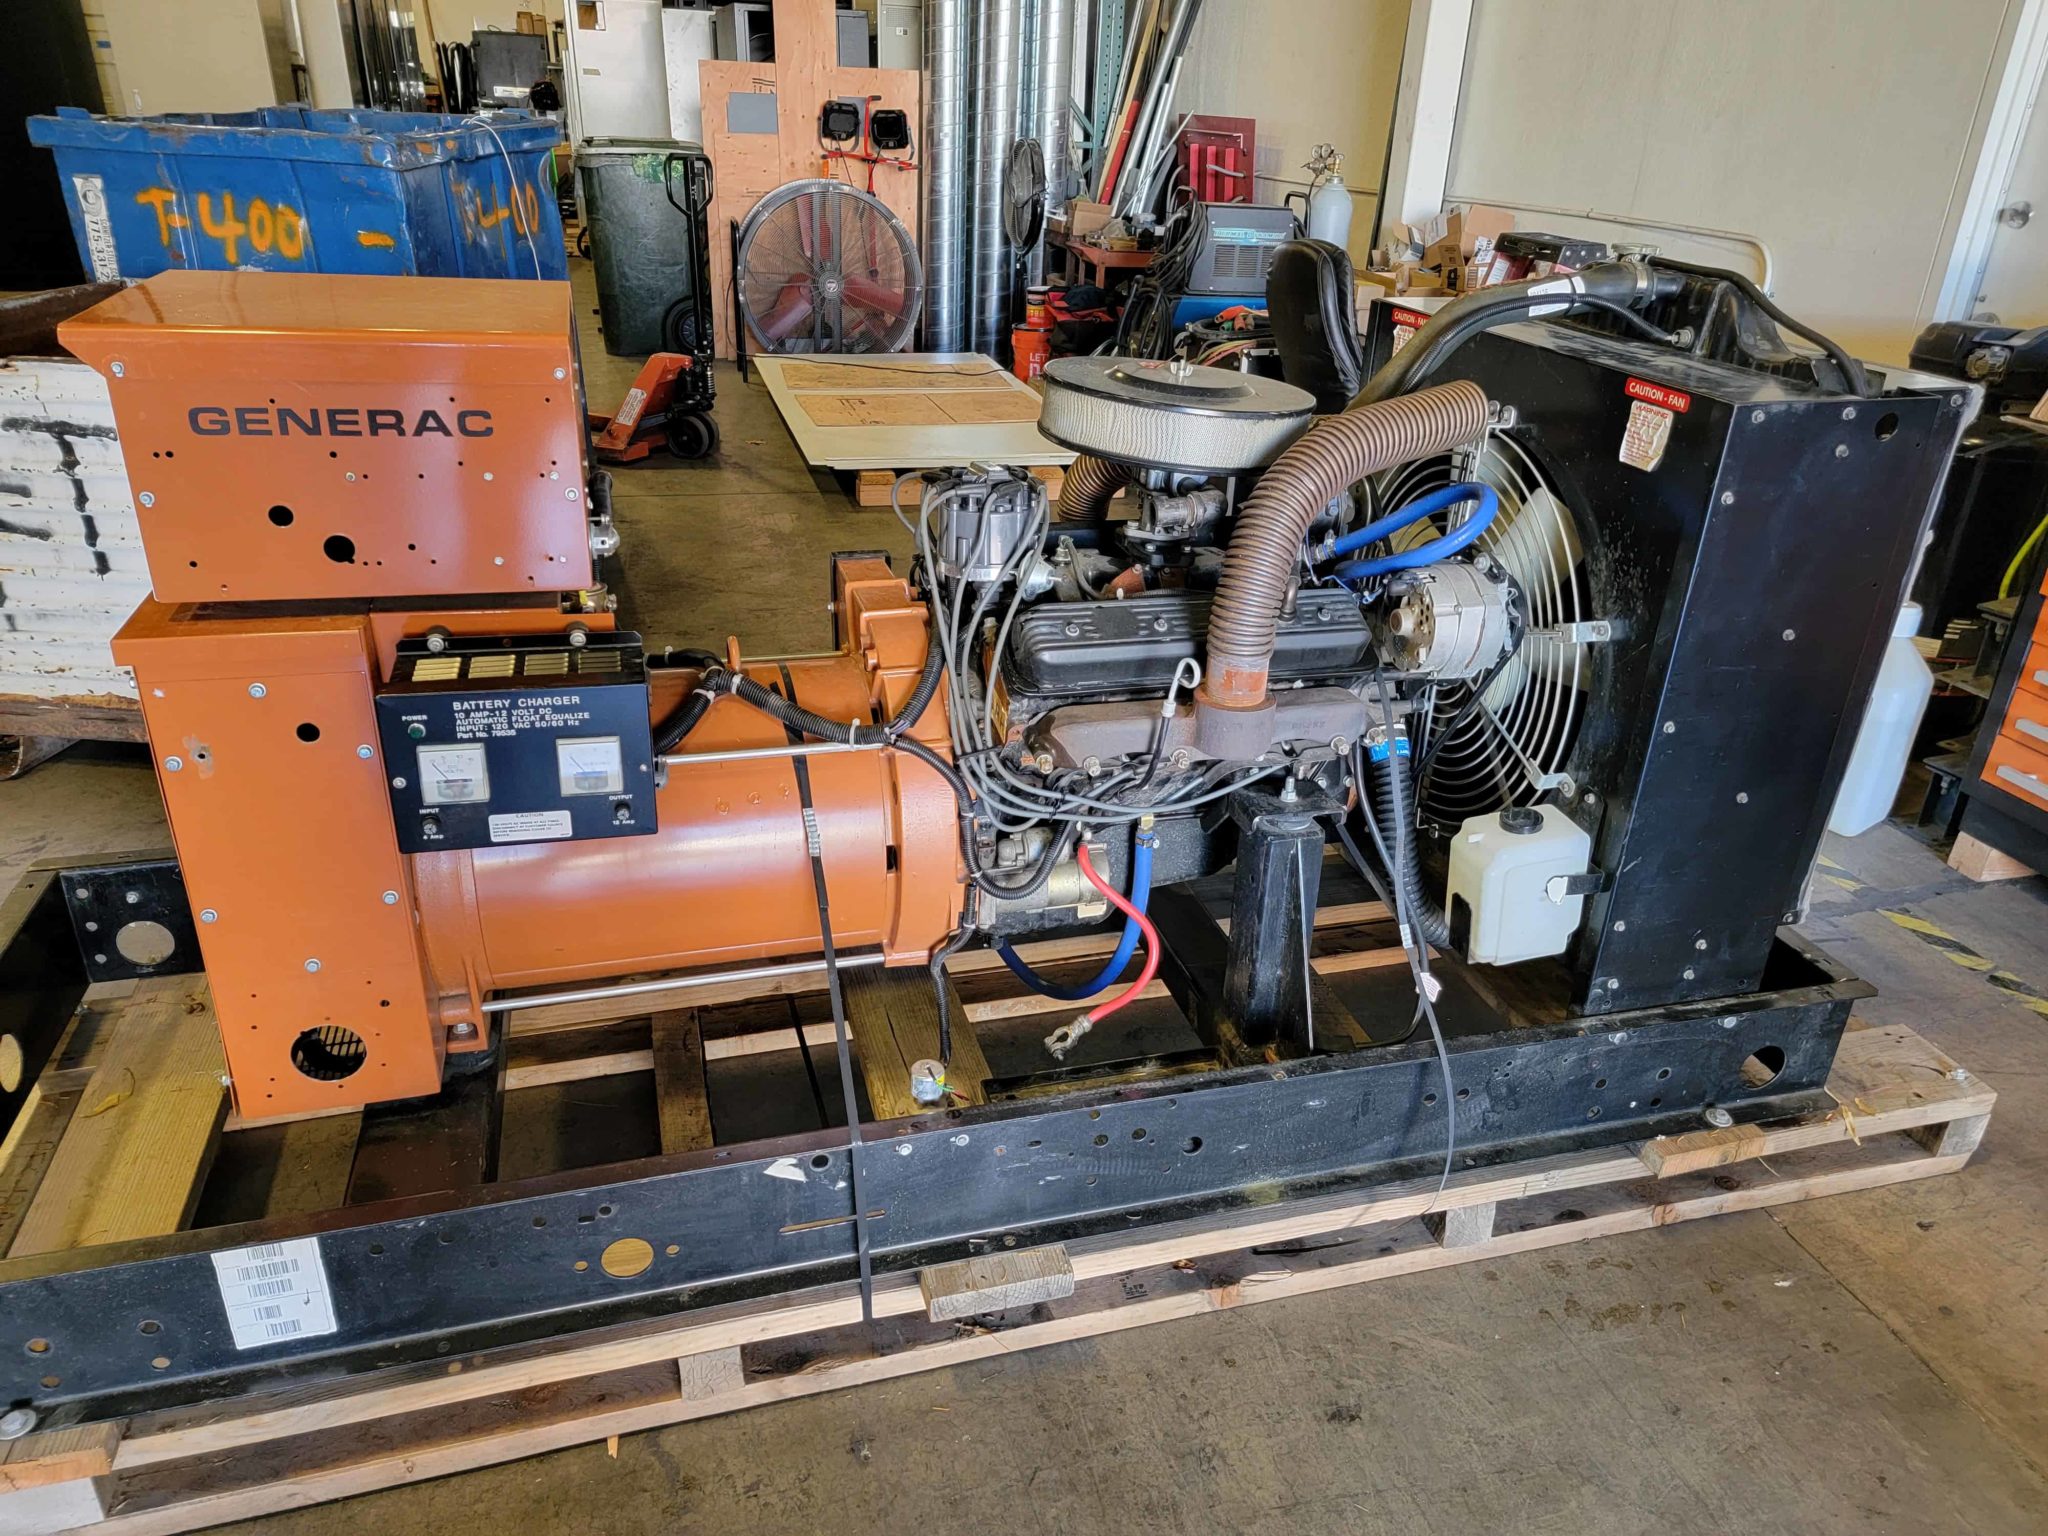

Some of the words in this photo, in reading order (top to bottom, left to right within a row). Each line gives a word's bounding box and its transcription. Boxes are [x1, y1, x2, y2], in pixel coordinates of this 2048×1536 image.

[136, 187, 303, 264] T-400
[1394, 311, 1416, 324] CAUTION
[1629, 382, 1664, 401] CAUTION
[1667, 394, 1686, 409] FAN
[1635, 405, 1670, 420] WARNING
[188, 407, 494, 438] GENERAC
[453, 699, 511, 711] BATTERY
[518, 696, 580, 707] CHARGER
[401, 714, 428, 722] POWER
[456, 717, 508, 726] AUTOMATIC
[512, 714, 541, 722] FLOAT
[545, 712, 590, 721] EQUALIZE
[470, 710, 508, 718] AMP-12
[512, 708, 535, 716] VOLT
[539, 707, 553, 715] DC
[456, 724, 489, 732] INPUT:
[513, 721, 531, 729] VAC
[608, 793, 633, 801] OUTPUT
